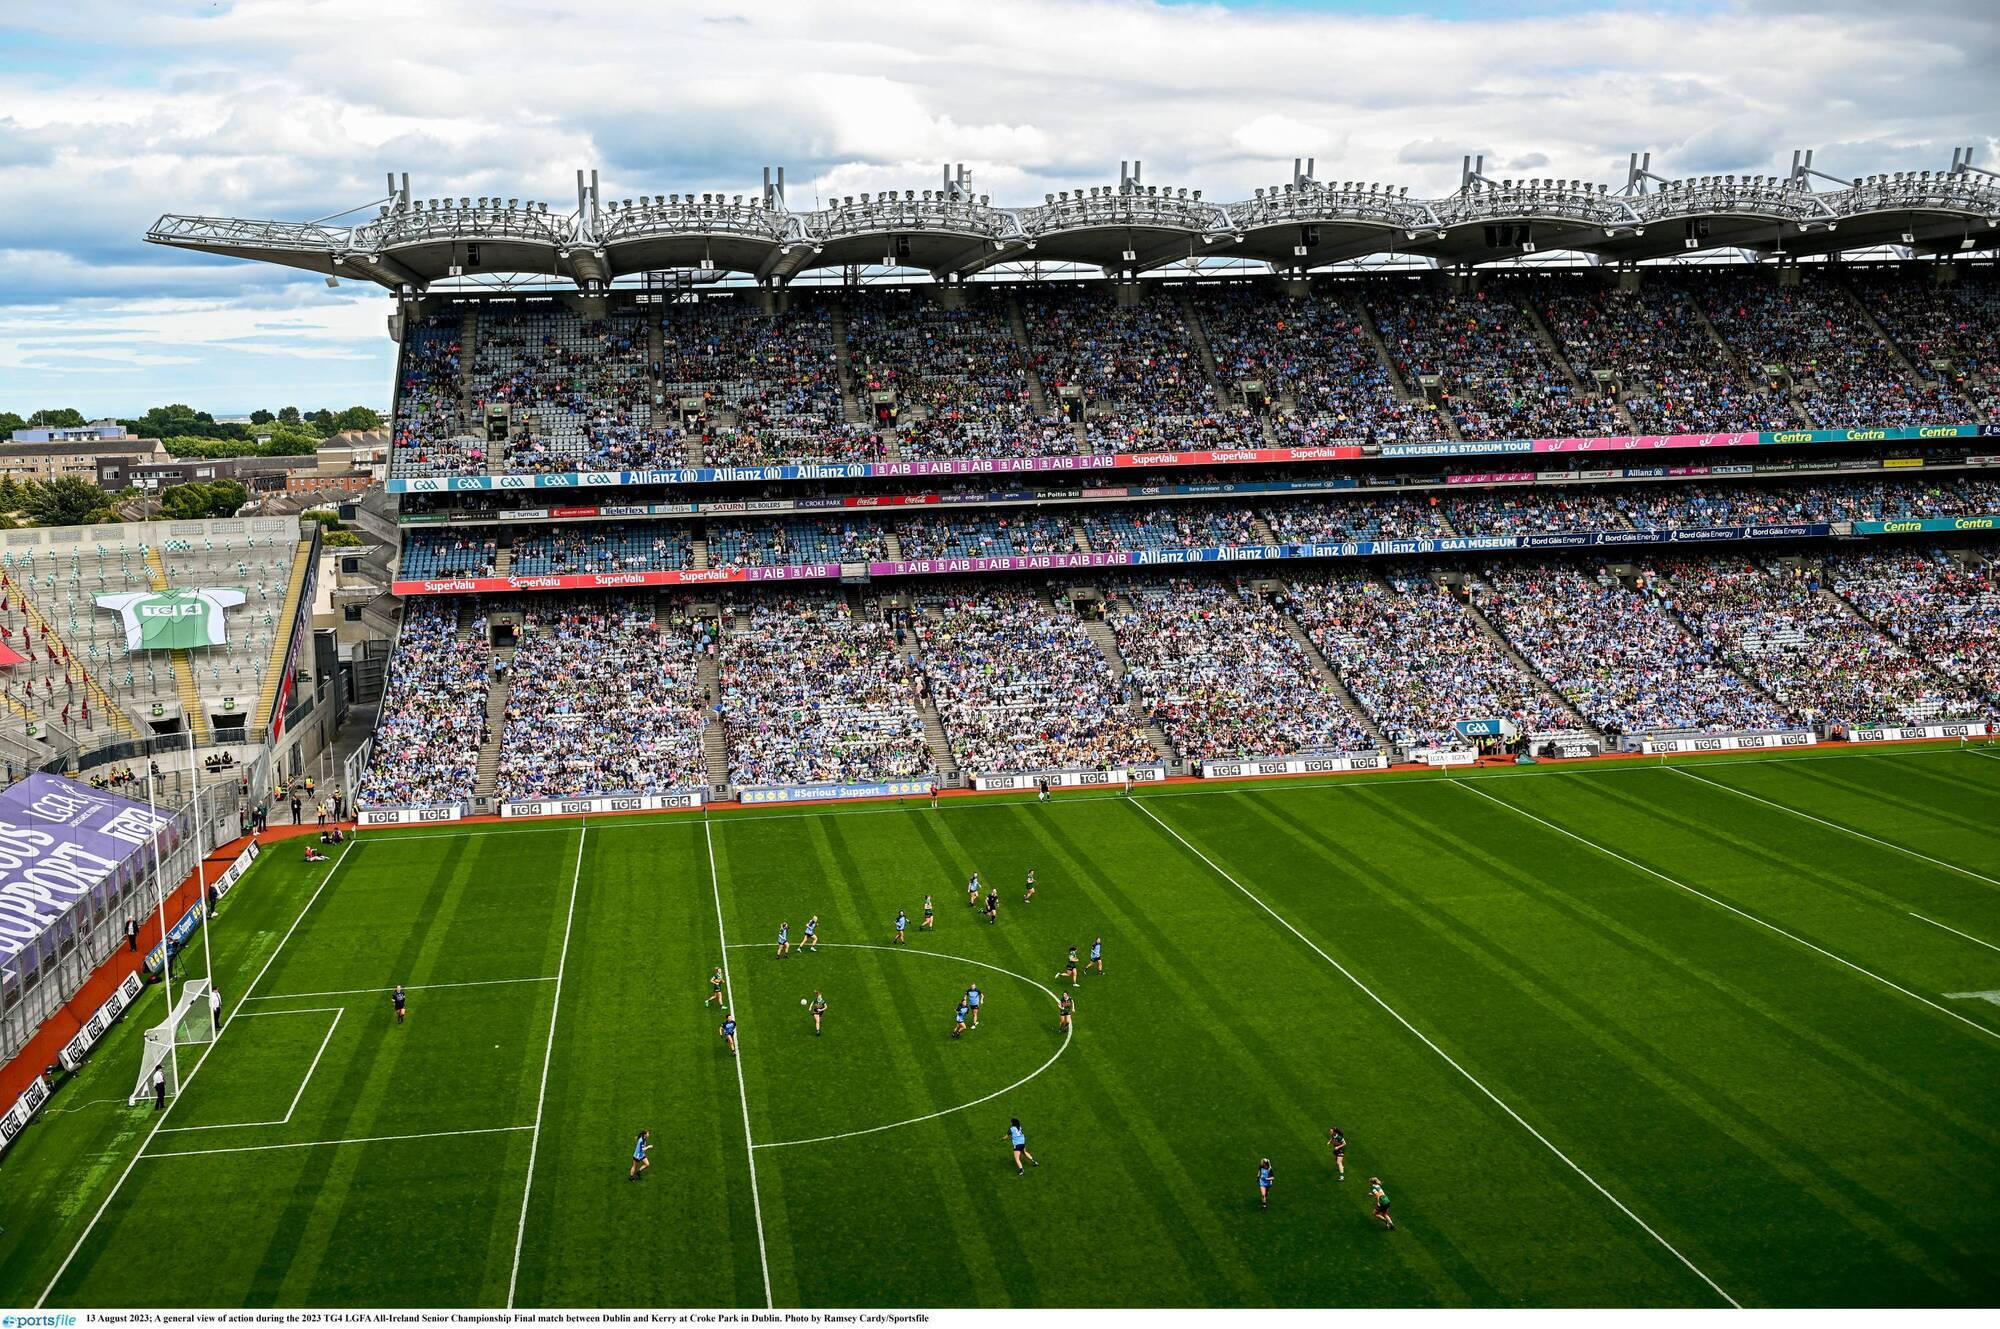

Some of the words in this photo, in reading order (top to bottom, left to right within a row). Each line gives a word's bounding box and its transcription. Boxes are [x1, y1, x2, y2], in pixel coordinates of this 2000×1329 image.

[1774, 432, 1812, 443] Centra
[1847, 430, 1885, 440] Centra
[1920, 427, 1957, 437] Centra
[1291, 449, 1335, 460] SuperValu
[1383, 447, 1405, 456] GAA
[1406, 445, 1448, 455] MUSEUM
[1450, 444, 1458, 453] &
[1459, 443, 1503, 452] STADIUM
[1504, 442, 1531, 451] TOUR
[1093, 457, 1113, 467] AIB
[1132, 455, 1178, 465] SuperValu
[1212, 452, 1256, 463] SuperValu
[890, 464, 911, 475] AIB
[931, 463, 952, 473] AIB
[972, 461, 993, 472] AIB
[1012, 460, 1033, 470] AIB
[1052, 459, 1073, 469] AIB
[713, 468, 761, 482] Allianz
[796, 464, 844, 478] Allianz
[1628, 469, 1652, 477] Allianz
[500, 477, 525, 487] GAA
[544, 476, 569, 486] GAA
[587, 474, 612, 484] GAA
[629, 470, 676, 484] Allianz
[414, 480, 439, 490] GAA
[458, 478, 482, 489] GAA
[713, 503, 744, 511] SATURN
[758, 501, 780, 509] BOILERS
[826, 499, 841, 507] PARK
[605, 507, 644, 515] Teleflex
[1884, 522, 1922, 532] Centra
[1955, 519, 1993, 529] Centra
[1711, 530, 1734, 538] Energy
[1784, 527, 1806, 535] Energy
[1531, 537, 1548, 545] Bord
[1563, 536, 1586, 545] Energy
[1637, 533, 1660, 541] Energy
[1371, 541, 1415, 554] Allianz
[1441, 540, 1467, 550] GAA
[1468, 538, 1516, 548] MUSEUM
[1107, 554, 1127, 564] AIB
[1138, 551, 1184, 564] Allianz
[1217, 548, 1262, 561] Allianz
[949, 560, 970, 570] AIB
[989, 558, 1010, 569] AIB
[1029, 557, 1050, 567] AIB
[1069, 555, 1090, 566] AIB
[805, 566, 826, 577] AIB
[909, 562, 929, 572] AIB
[680, 571, 728, 582] SuperValu
[763, 568, 785, 579] AIB
[595, 575, 645, 586] SuperValu
[425, 581, 475, 592] SuperValu
[1467, 722, 1490, 734] GAA
[1901, 728, 1927, 738] TG4
[1943, 726, 1968, 736] TG4
[1781, 734, 1808, 745] TG4
[1858, 731, 1884, 741] TG4
[1651, 742, 1678, 752] TG4
[1694, 739, 1721, 750] TG4
[1738, 737, 1764, 747] TG4
[1260, 762, 1287, 773] TG4
[1305, 760, 1332, 771] TG4
[1351, 758, 1378, 769] TG4
[1213, 764, 1241, 776] TG4
[1034, 775, 1061, 786] T4
[1081, 771, 1107, 783] TG4
[986, 778, 1013, 788] TG4
[794, 788, 836, 798] #Serious
[840, 786, 880, 798] Support
[612, 798, 641, 810] TG4
[661, 795, 691, 807] TG4
[512, 803, 542, 815] TG4
[562, 801, 592, 813] TG4
[369, 811, 399, 823] TG4
[421, 808, 450, 820] TG4
[123, 976, 139, 998] TG4
[106, 995, 122, 1018] TG4
[87, 1015, 104, 1040] TG4
[67, 1037, 85, 1063] TG4
[24, 1083, 43, 1111] TG4
[0, 1112, 21, 1139] TG4
